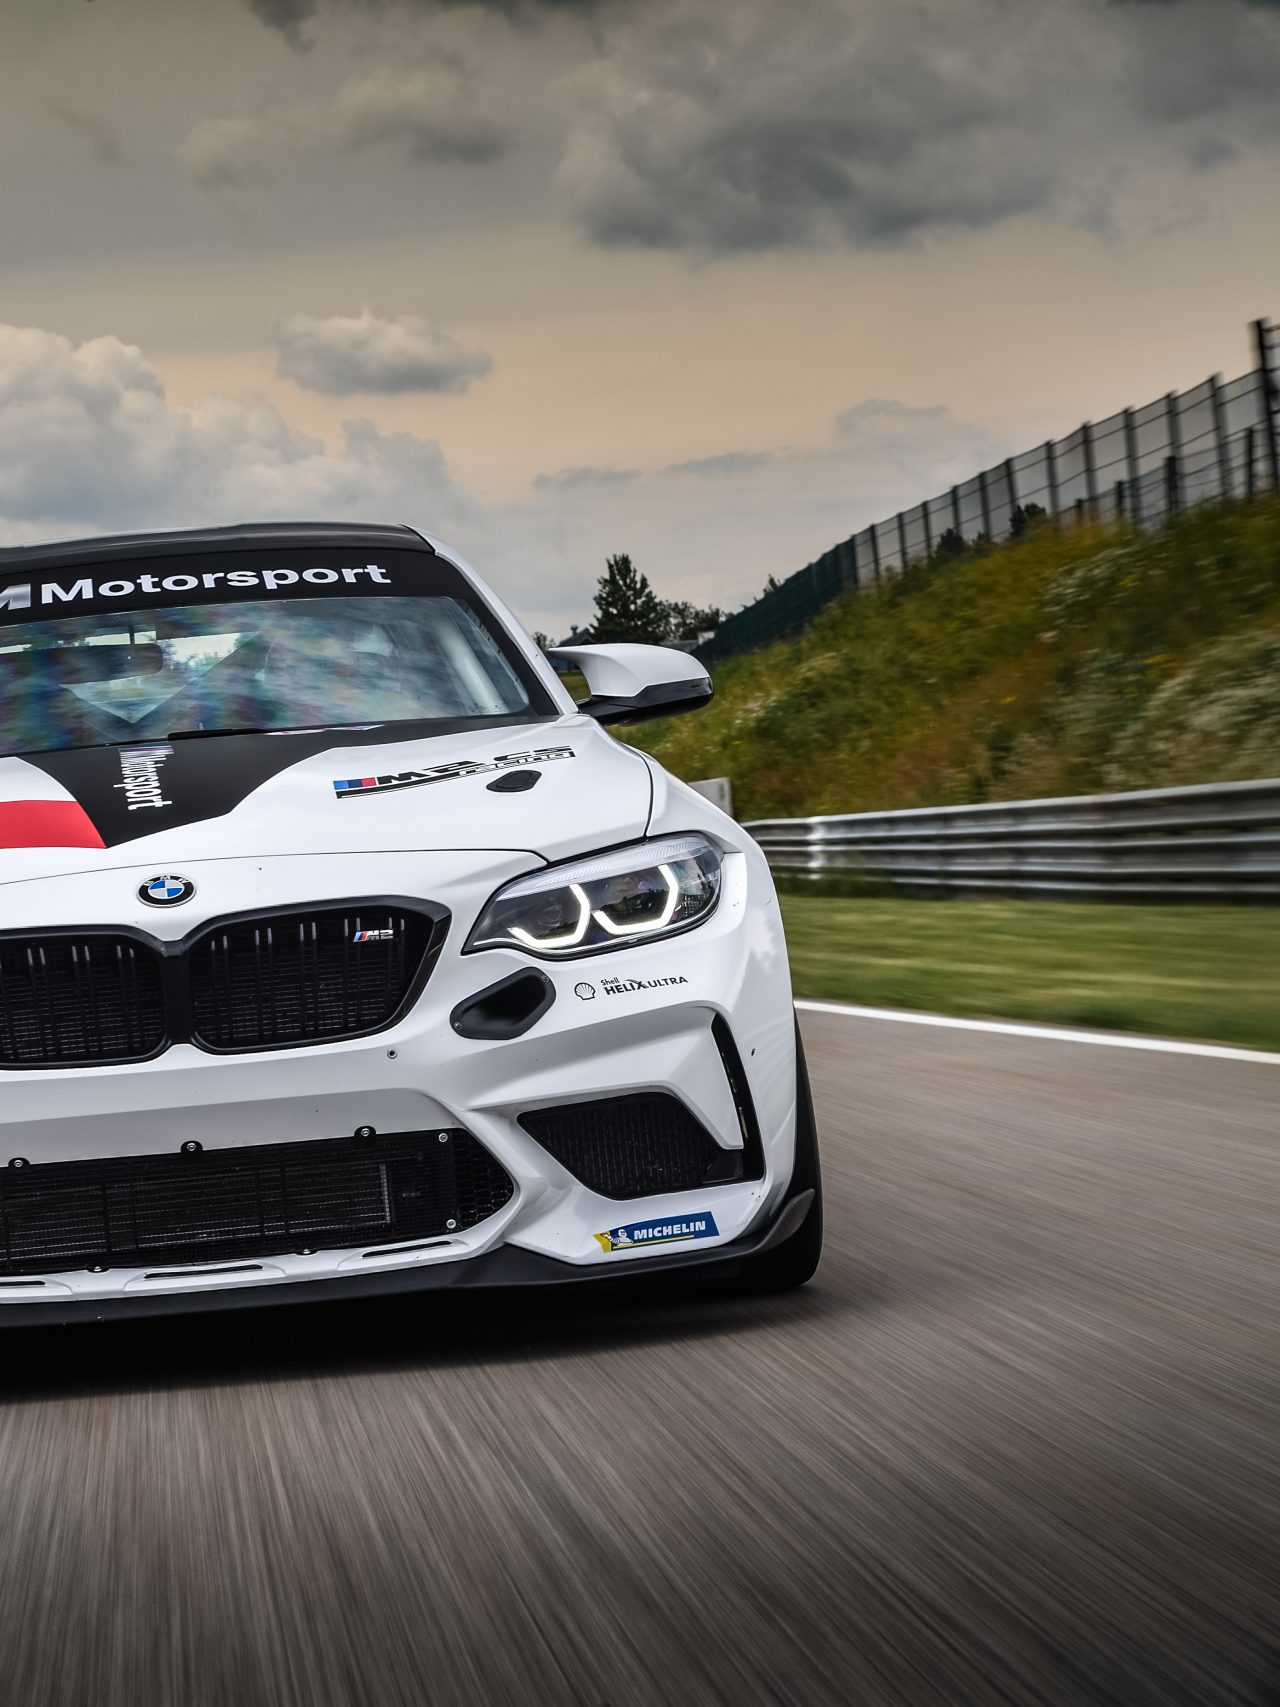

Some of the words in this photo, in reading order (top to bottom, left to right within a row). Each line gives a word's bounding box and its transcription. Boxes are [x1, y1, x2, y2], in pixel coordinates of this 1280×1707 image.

[41, 564, 392, 605] Motorsport
[142, 875, 190, 887] BMW
[601, 977, 620, 986] Shell
[603, 979, 648, 996] HELIX
[647, 976, 689, 989] ULTRA
[633, 1220, 706, 1240] MICHELIN
